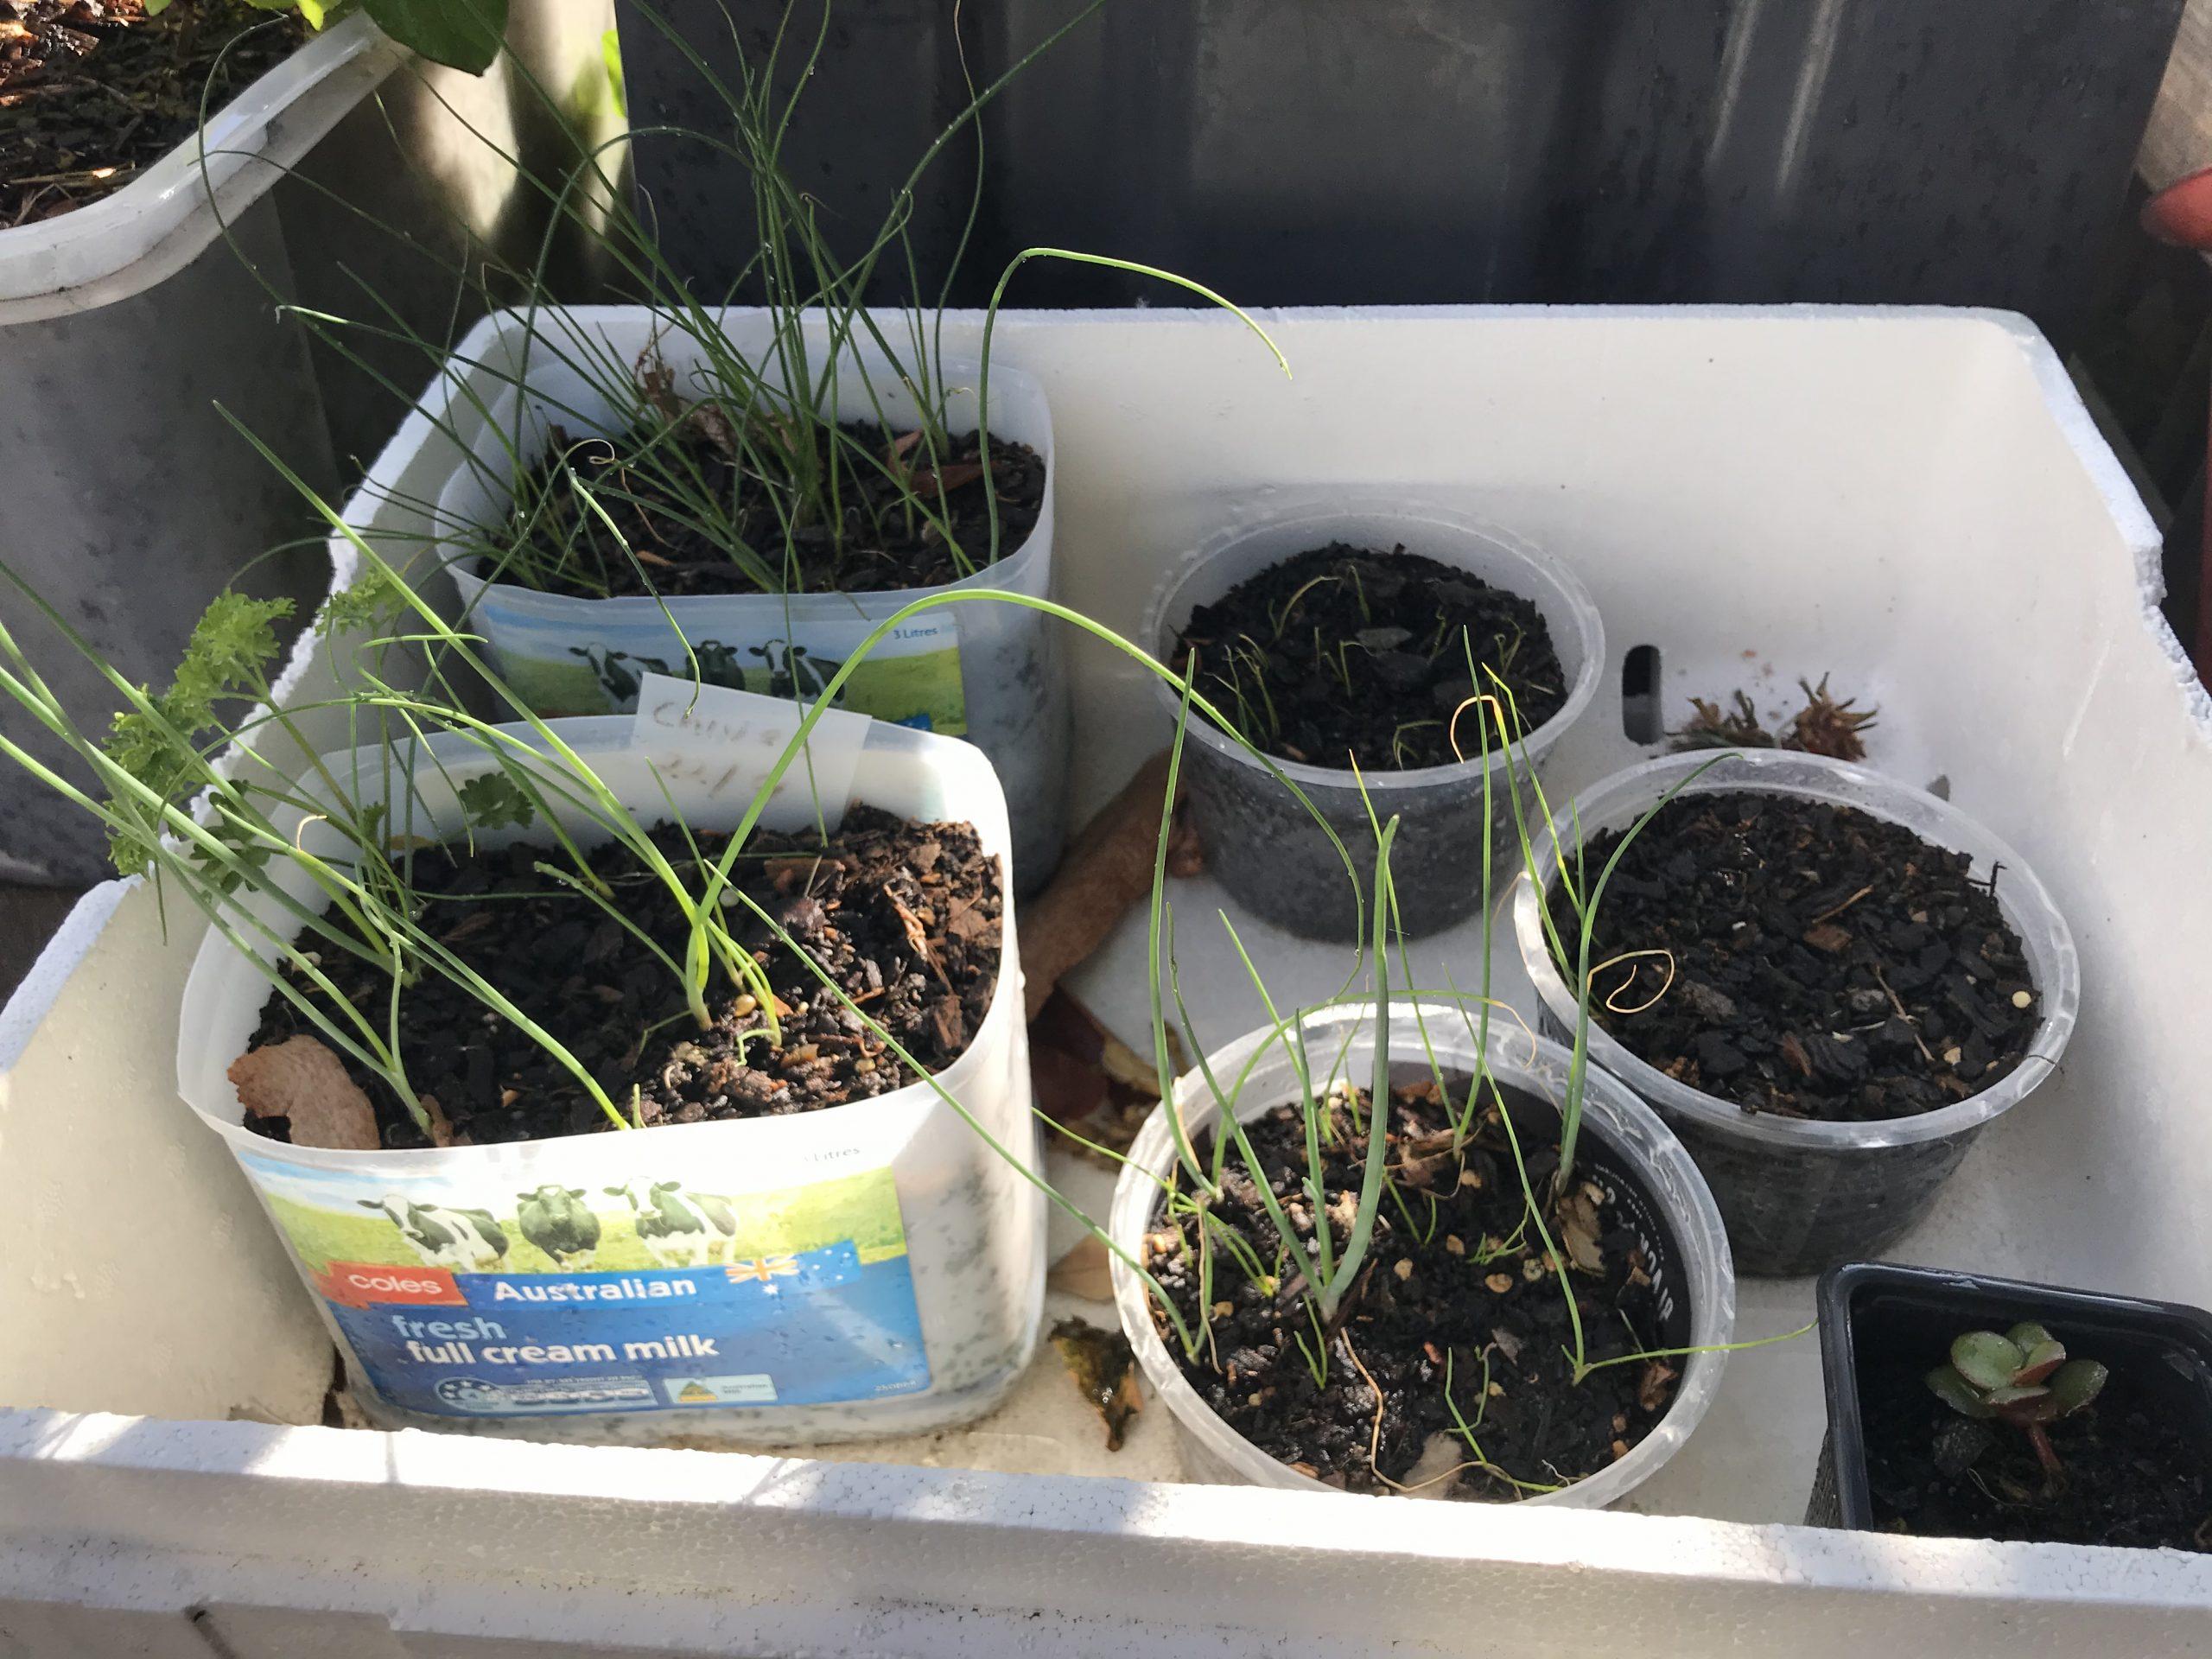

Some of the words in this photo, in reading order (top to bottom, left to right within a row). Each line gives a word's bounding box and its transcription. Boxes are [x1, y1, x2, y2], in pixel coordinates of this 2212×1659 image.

[893, 629, 901, 640] 3
[903, 627, 939, 639] Litres
[349, 1274, 443, 1294] coles
[493, 1278, 697, 1302] Australian
[391, 1314, 507, 1340] fresh
[406, 1339, 477, 1365] full
[481, 1341, 619, 1365] cream
[621, 1333, 721, 1362] milk
